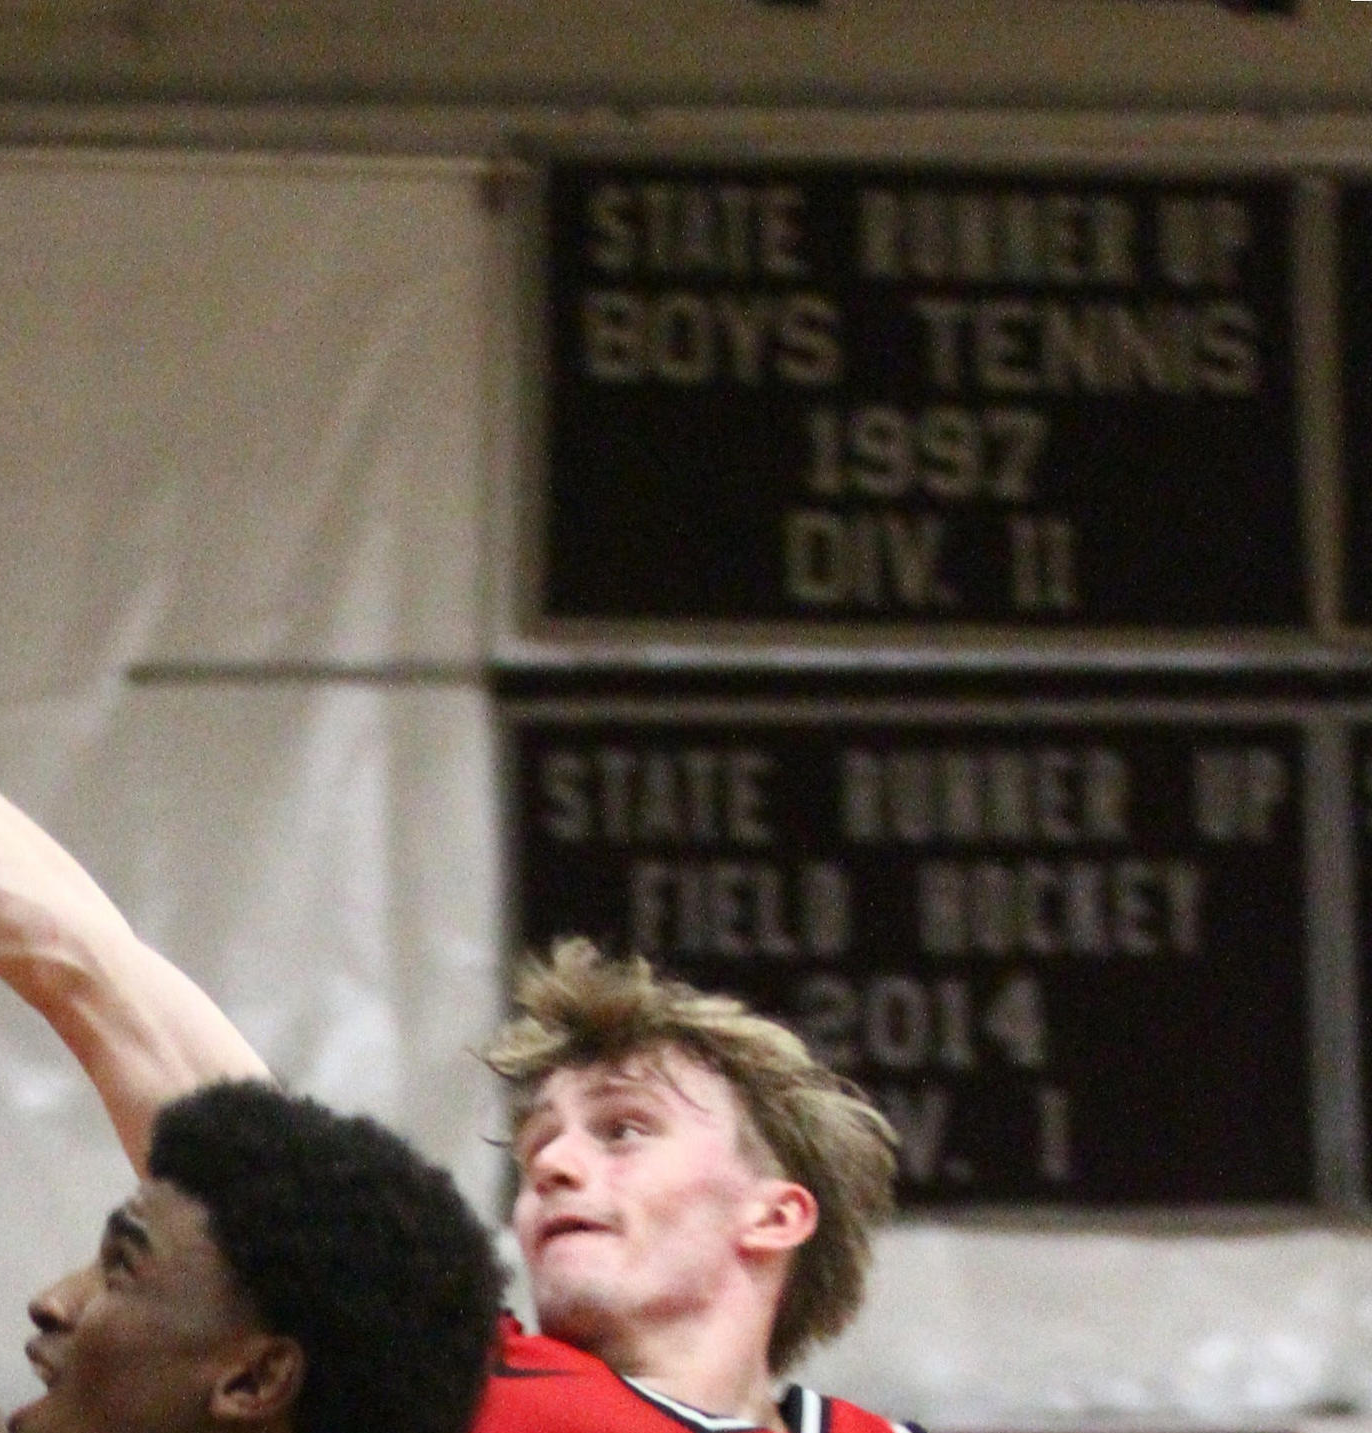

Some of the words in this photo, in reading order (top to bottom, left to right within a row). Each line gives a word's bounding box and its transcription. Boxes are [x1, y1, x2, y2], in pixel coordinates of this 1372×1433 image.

[583, 180, 810, 275] STATE
[855, 187, 1134, 280] RUNNER
[1152, 198, 1253, 286] UP
[577, 289, 844, 385] BOYS
[909, 296, 1262, 394] TENNIS
[803, 404, 1052, 500] 1997
[539, 745, 773, 844] STATE
[838, 745, 1134, 844] RUNNER
[1190, 745, 1292, 843] UP
[628, 856, 852, 957] FIELD
[914, 856, 1205, 957] HOCKEY
[796, 972, 1046, 1072] 2014
